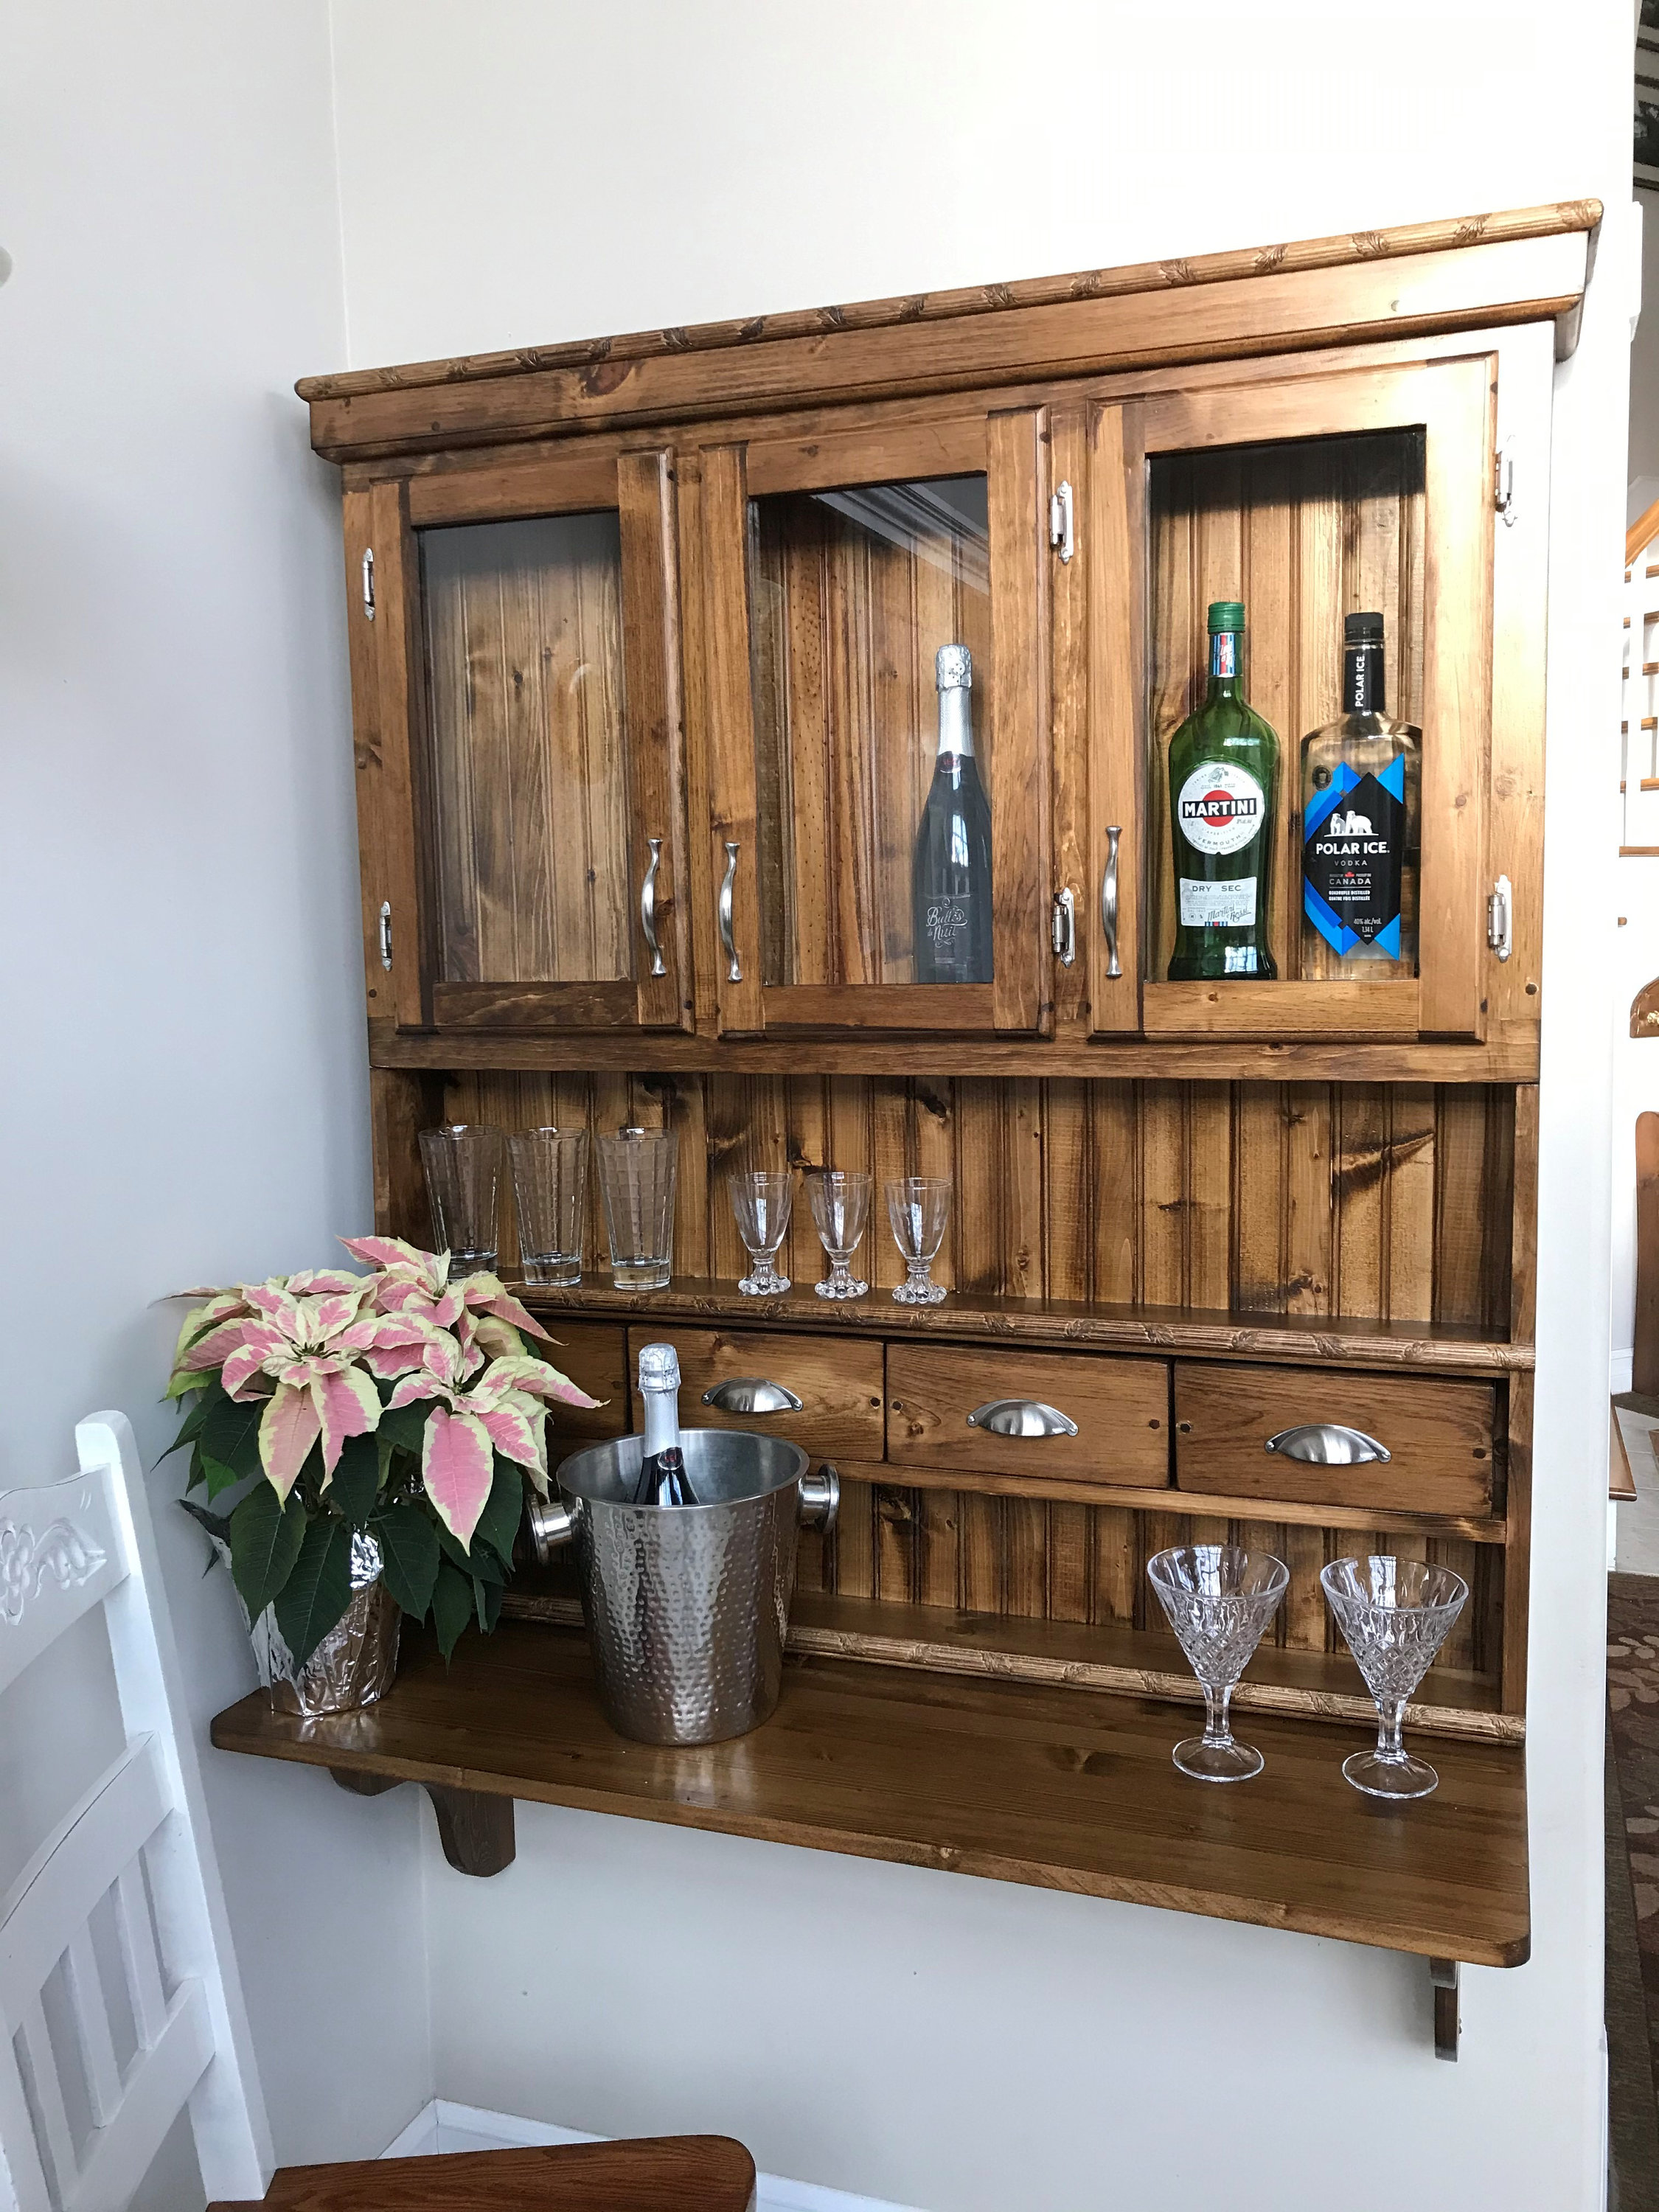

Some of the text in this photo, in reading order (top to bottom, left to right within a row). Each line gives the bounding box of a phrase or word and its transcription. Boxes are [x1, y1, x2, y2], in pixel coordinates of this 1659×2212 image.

[1354, 655, 1366, 707] POLAR ICE
[1184, 799, 1254, 817] MARTINI
[1198, 835, 1242, 846] VERMOUTH
[1316, 841, 1388, 855] POLAR ICE
[1208, 904, 1235, 922] Martini
[933, 925, 956, 940] Nuit
